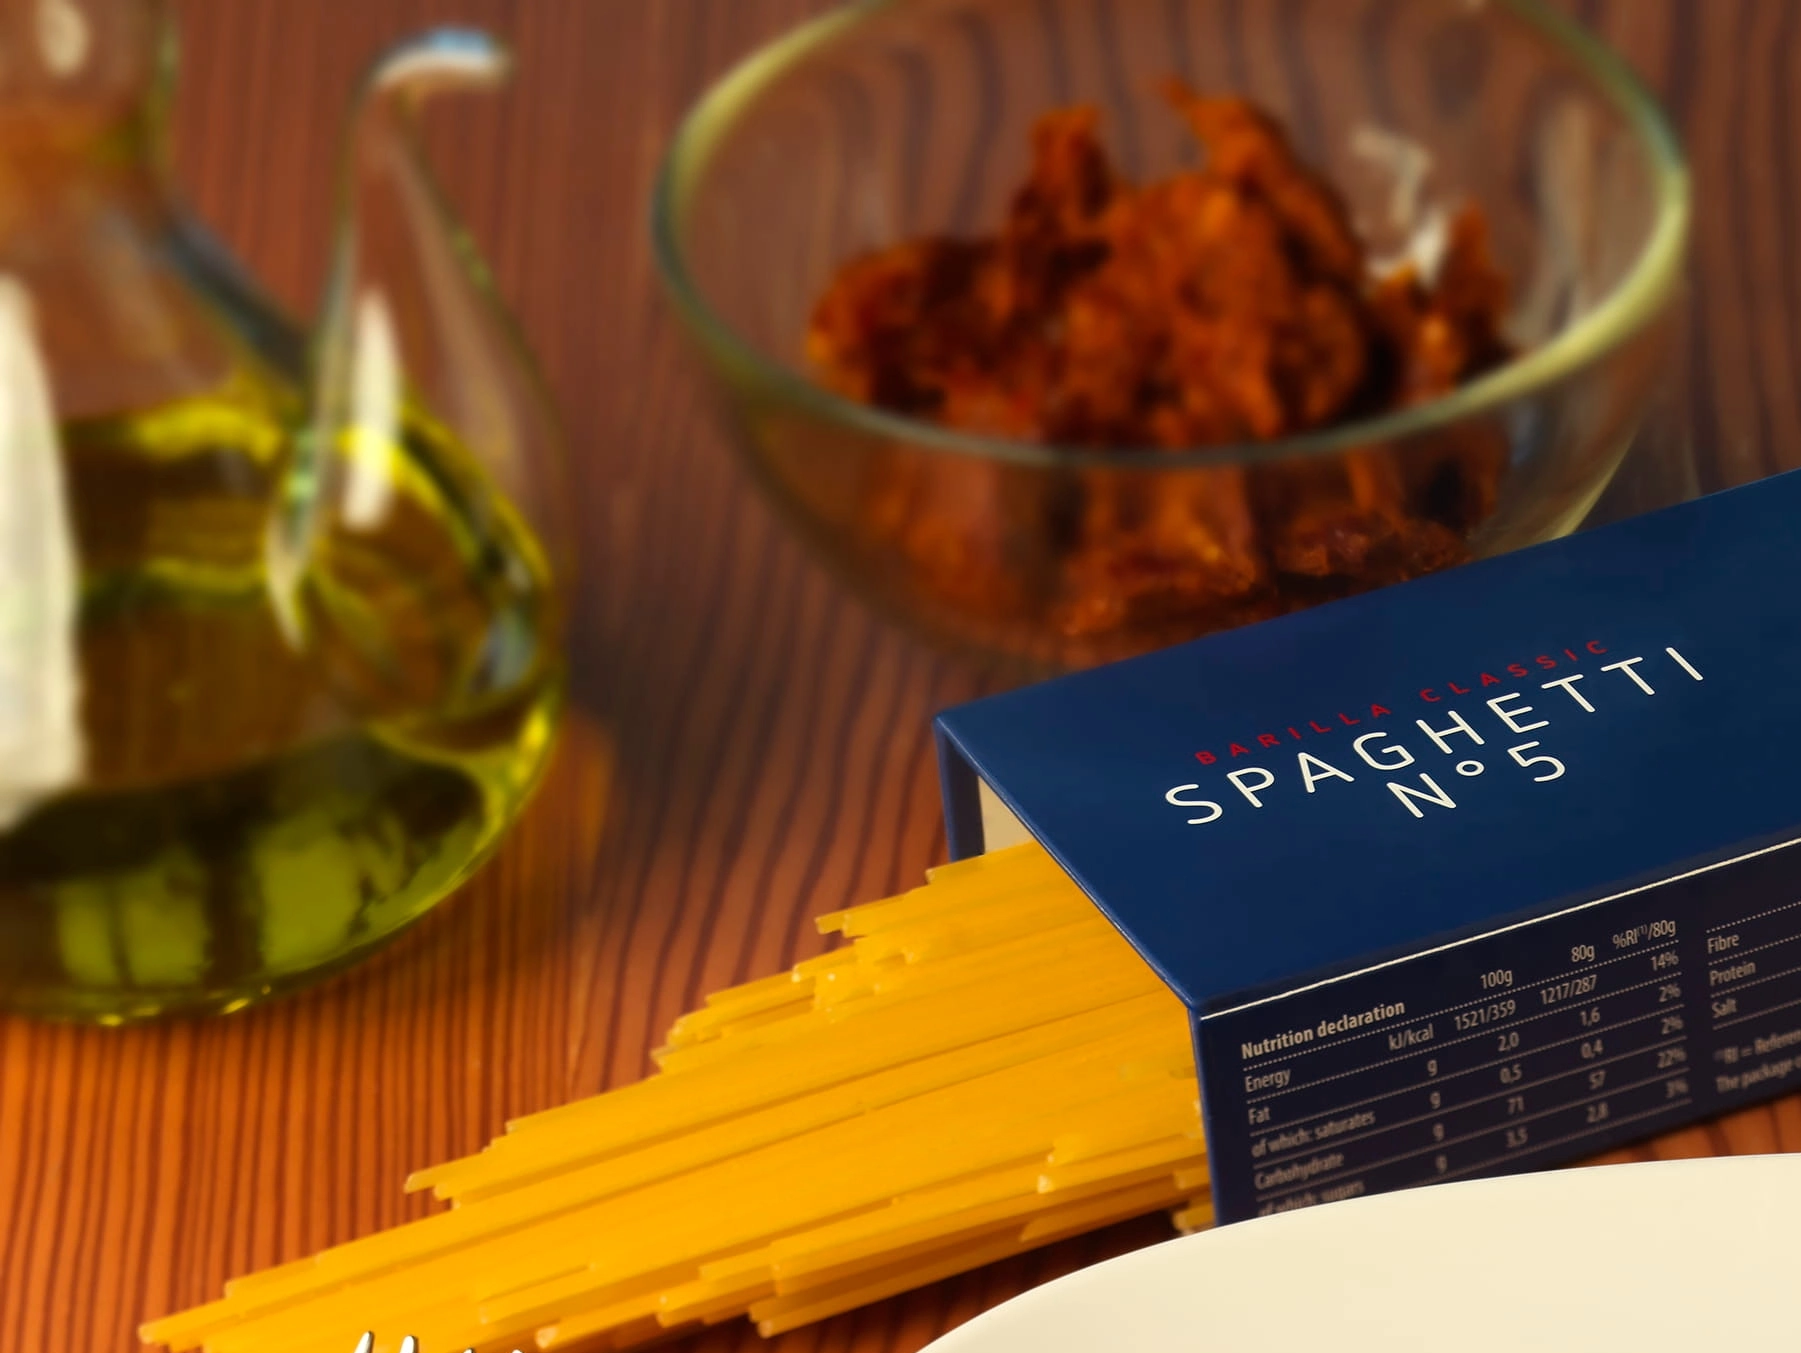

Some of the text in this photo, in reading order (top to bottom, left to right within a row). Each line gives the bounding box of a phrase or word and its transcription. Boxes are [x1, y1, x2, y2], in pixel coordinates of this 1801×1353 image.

[1165, 647, 1703, 824] SPAGHETTI
[1195, 640, 1607, 766] BARILLA CLASSIC
[1707, 934, 1740, 954] Fibre
[1710, 961, 1756, 985] Protein
[1241, 1027, 1313, 1060] Nutrition
[1317, 1002, 1405, 1038] declaration
[1480, 969, 1513, 989] 100g
[1571, 945, 1595, 962] 80g
[1245, 951, 1678, 1092] Energy kJ/kcal 1521/359 1217/287 14%
[1712, 998, 1737, 1018] Salt
[1248, 1107, 1270, 1124] Fat
[1427, 1059, 1438, 1076] g
